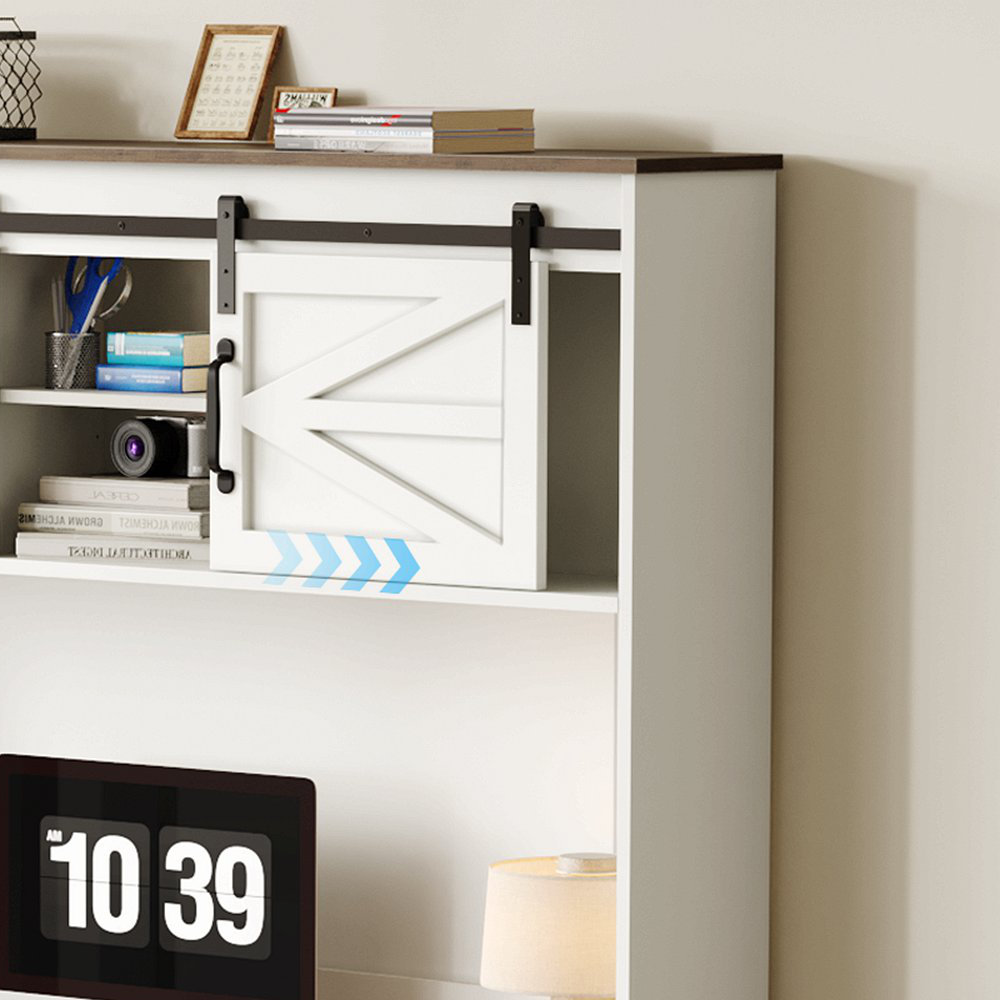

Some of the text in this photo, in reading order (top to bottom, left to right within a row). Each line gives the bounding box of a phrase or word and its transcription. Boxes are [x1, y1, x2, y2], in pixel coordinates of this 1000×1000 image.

[46, 829, 63, 842] AM
[50, 832, 265, 946] 10 39
